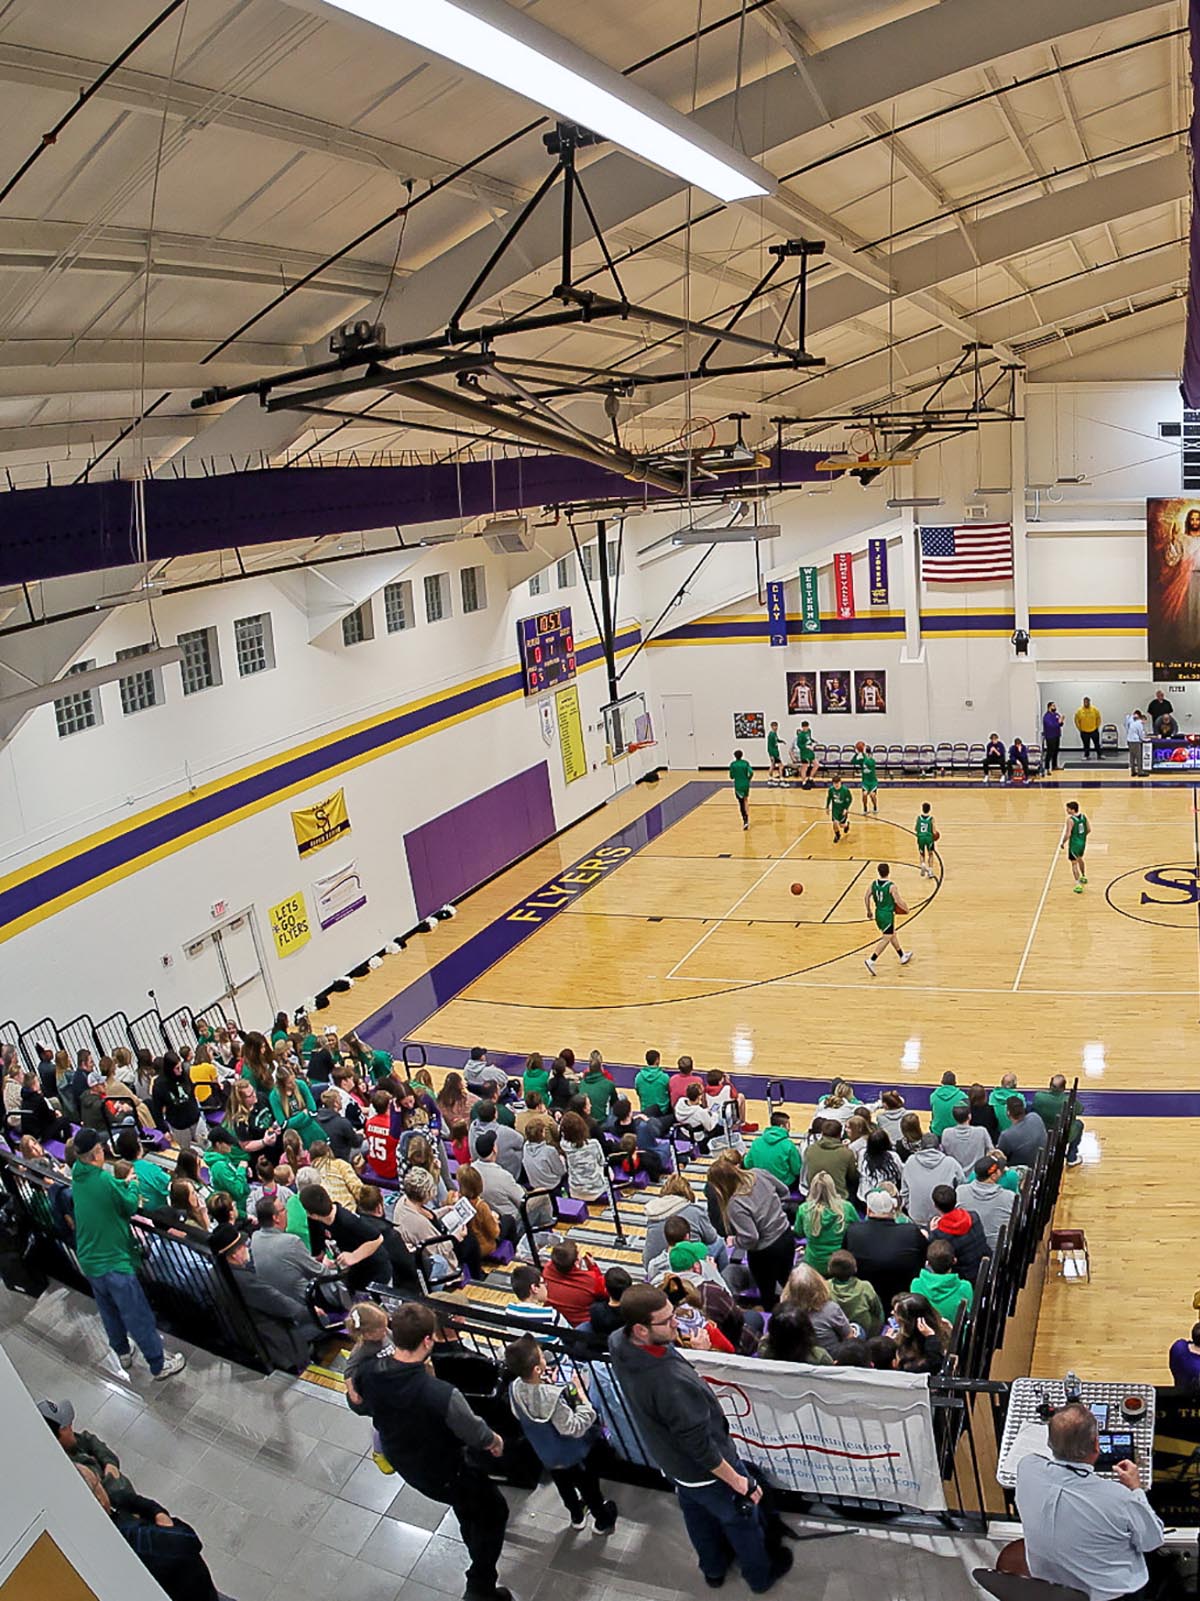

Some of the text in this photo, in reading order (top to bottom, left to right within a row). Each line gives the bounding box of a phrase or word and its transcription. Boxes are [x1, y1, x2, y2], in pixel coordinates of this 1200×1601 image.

[771, 584, 781, 621] CLAY
[803, 568, 815, 619] WESTERN
[506, 846, 633, 922] FLYERS
[274, 899, 299, 921] LETS
[280, 915, 296, 931] GO
[278, 920, 309, 947] FLYERS
[368, 1136, 387, 1161] 15
